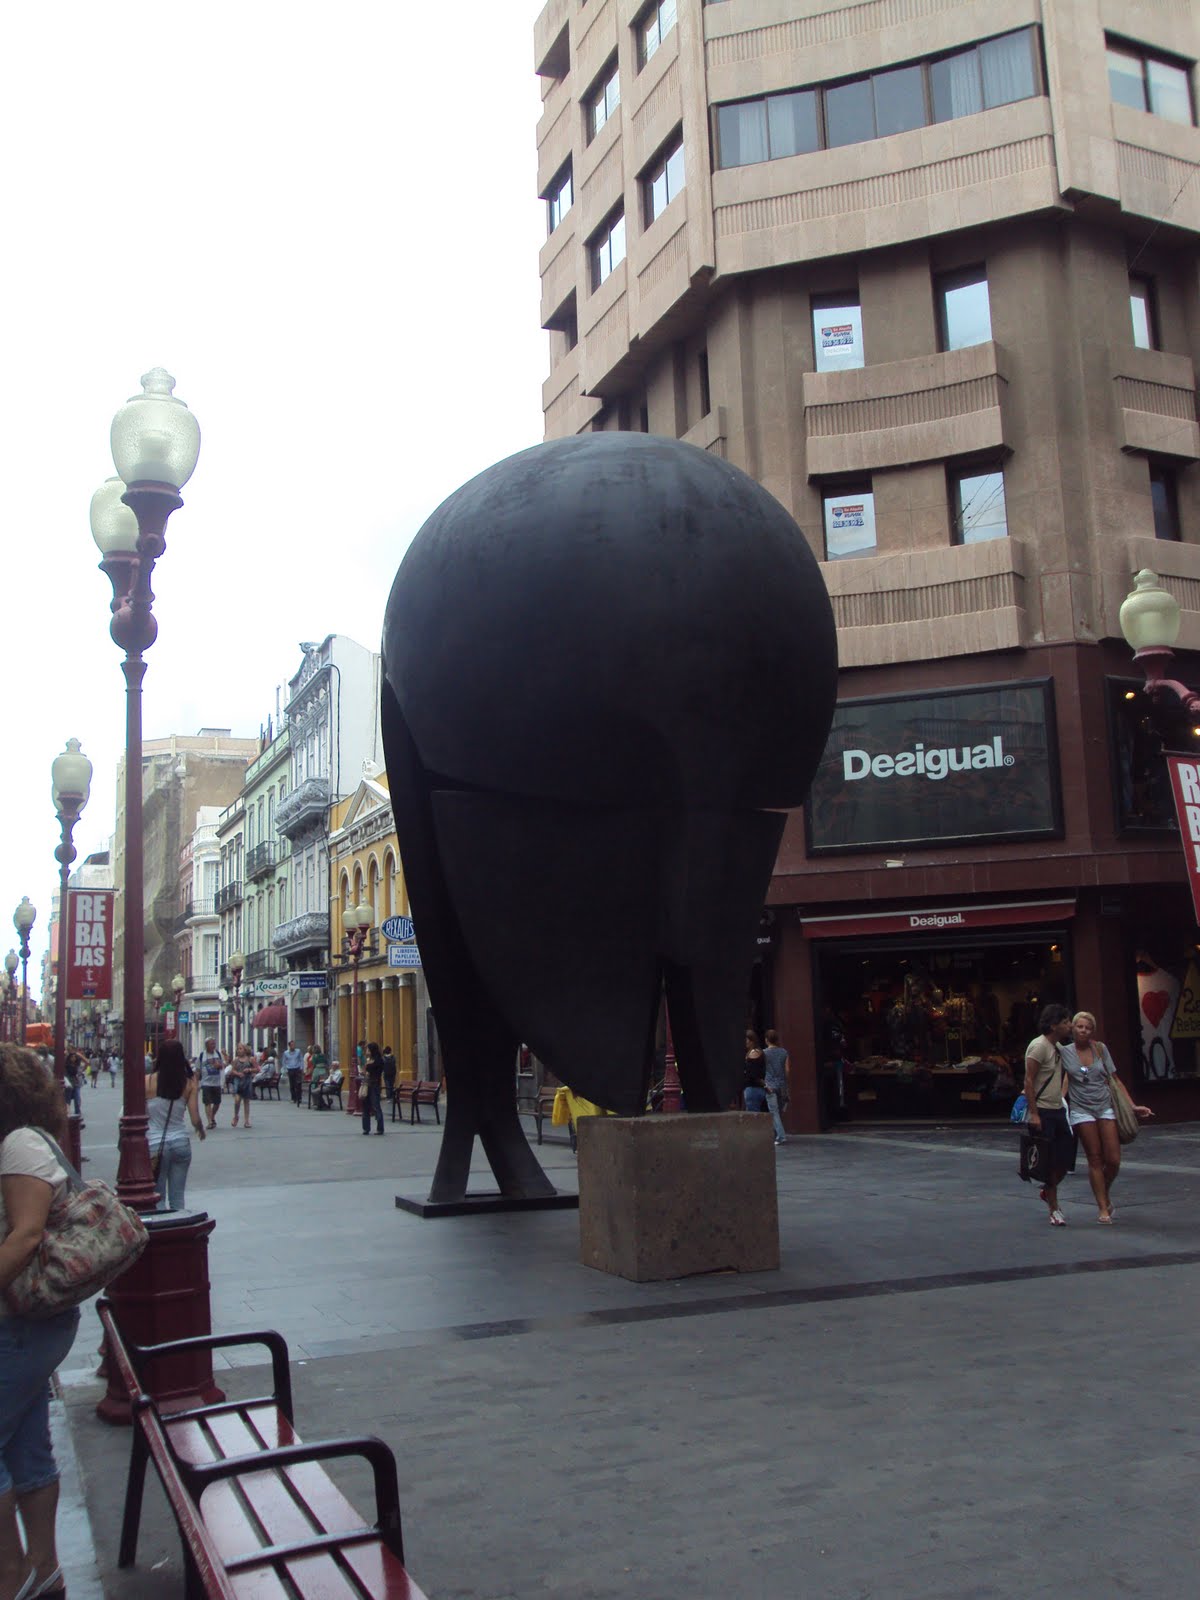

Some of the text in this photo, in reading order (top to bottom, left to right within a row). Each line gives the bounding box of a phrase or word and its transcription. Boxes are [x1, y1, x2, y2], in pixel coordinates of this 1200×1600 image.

[76, 895, 106, 922] RE
[910, 913, 962, 926] Desigual
[75, 922, 106, 946] BA
[74, 947, 105, 966] JAS
[256, 981, 287, 992] Rocasa
